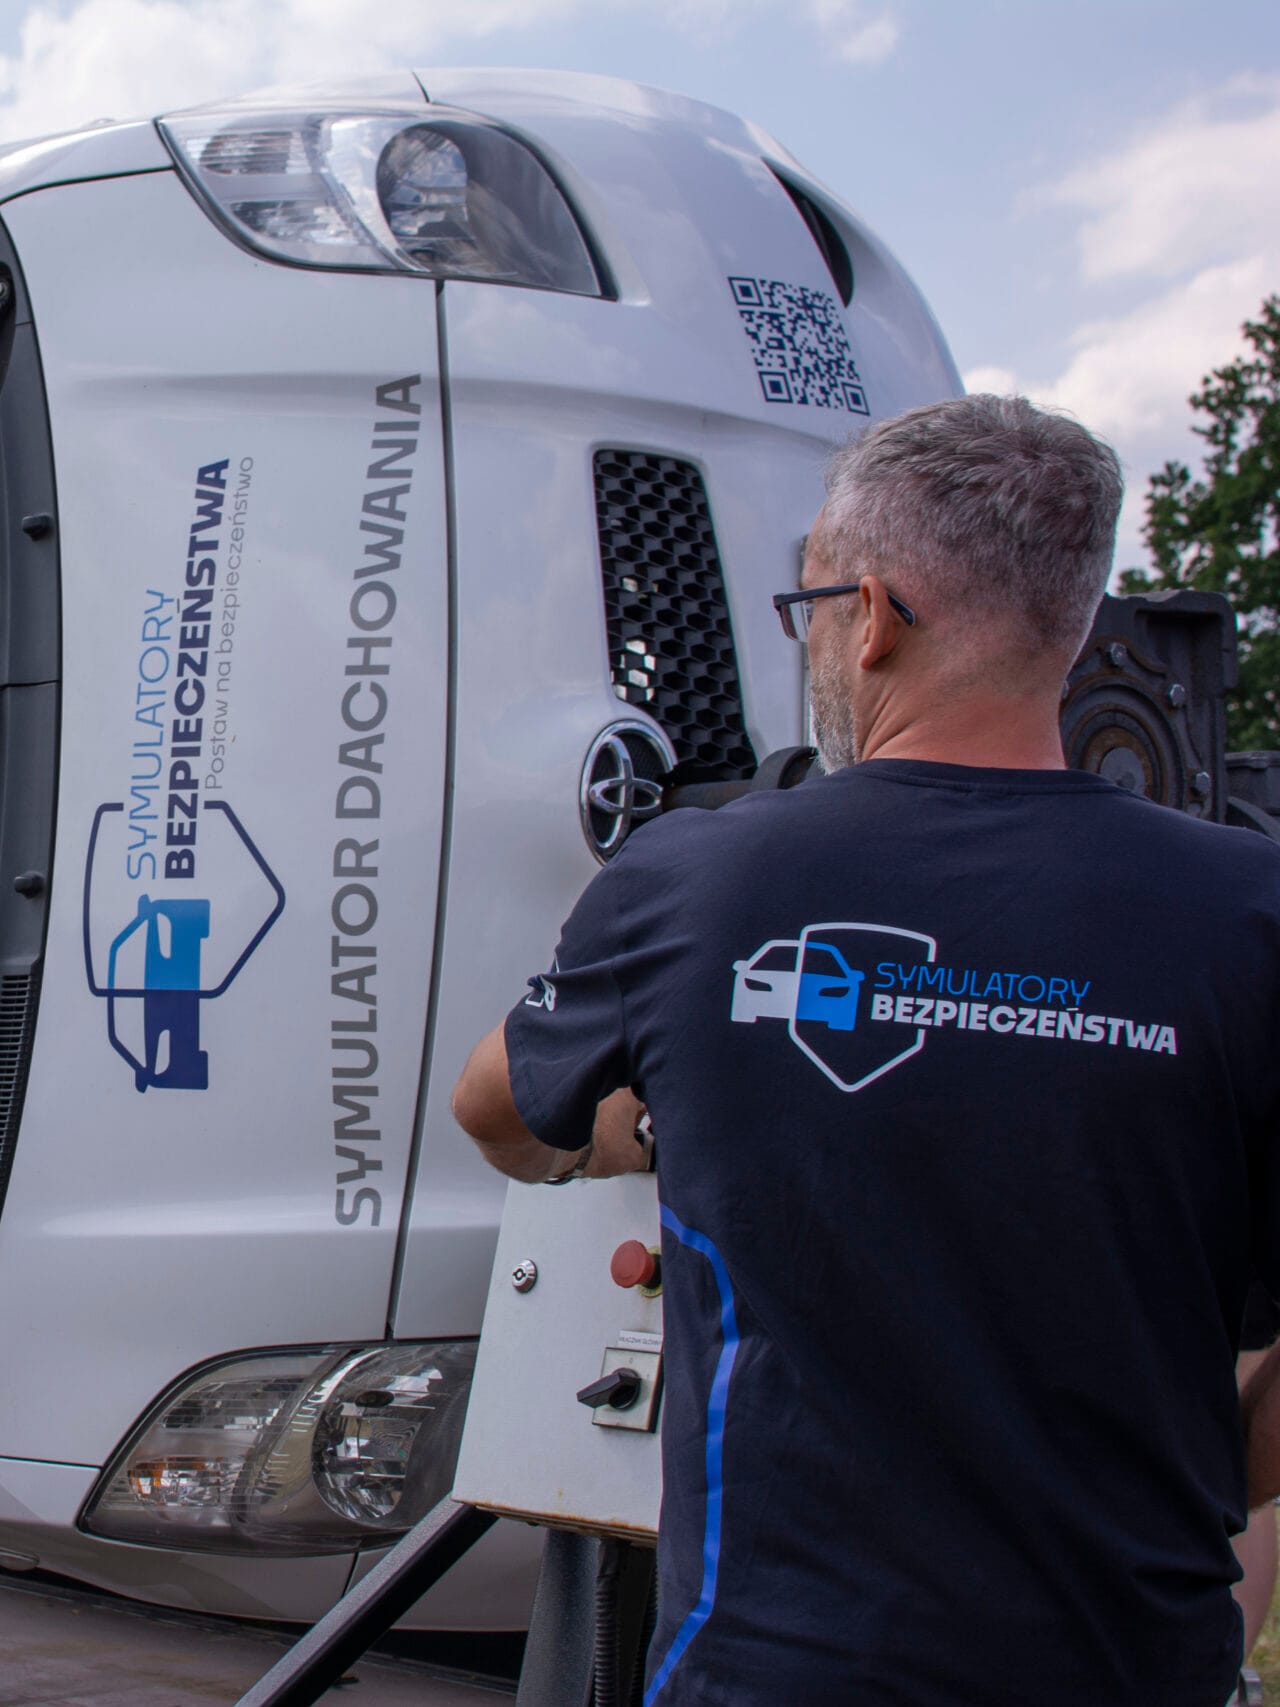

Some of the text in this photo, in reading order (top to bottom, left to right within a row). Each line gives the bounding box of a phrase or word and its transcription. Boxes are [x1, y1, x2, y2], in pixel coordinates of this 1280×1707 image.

[126, 589, 175, 880] SYMULATORY
[164, 458, 229, 879] BEZPIECZEŃSTWA
[204, 456, 254, 789] Postaw na bezpieczeństwo
[331, 373, 422, 1227] SYMULATOR DACHOWANIA
[871, 993, 1177, 1055] BEZPIECZEŃSTWA
[874, 962, 1091, 1006] SYMULATORY
